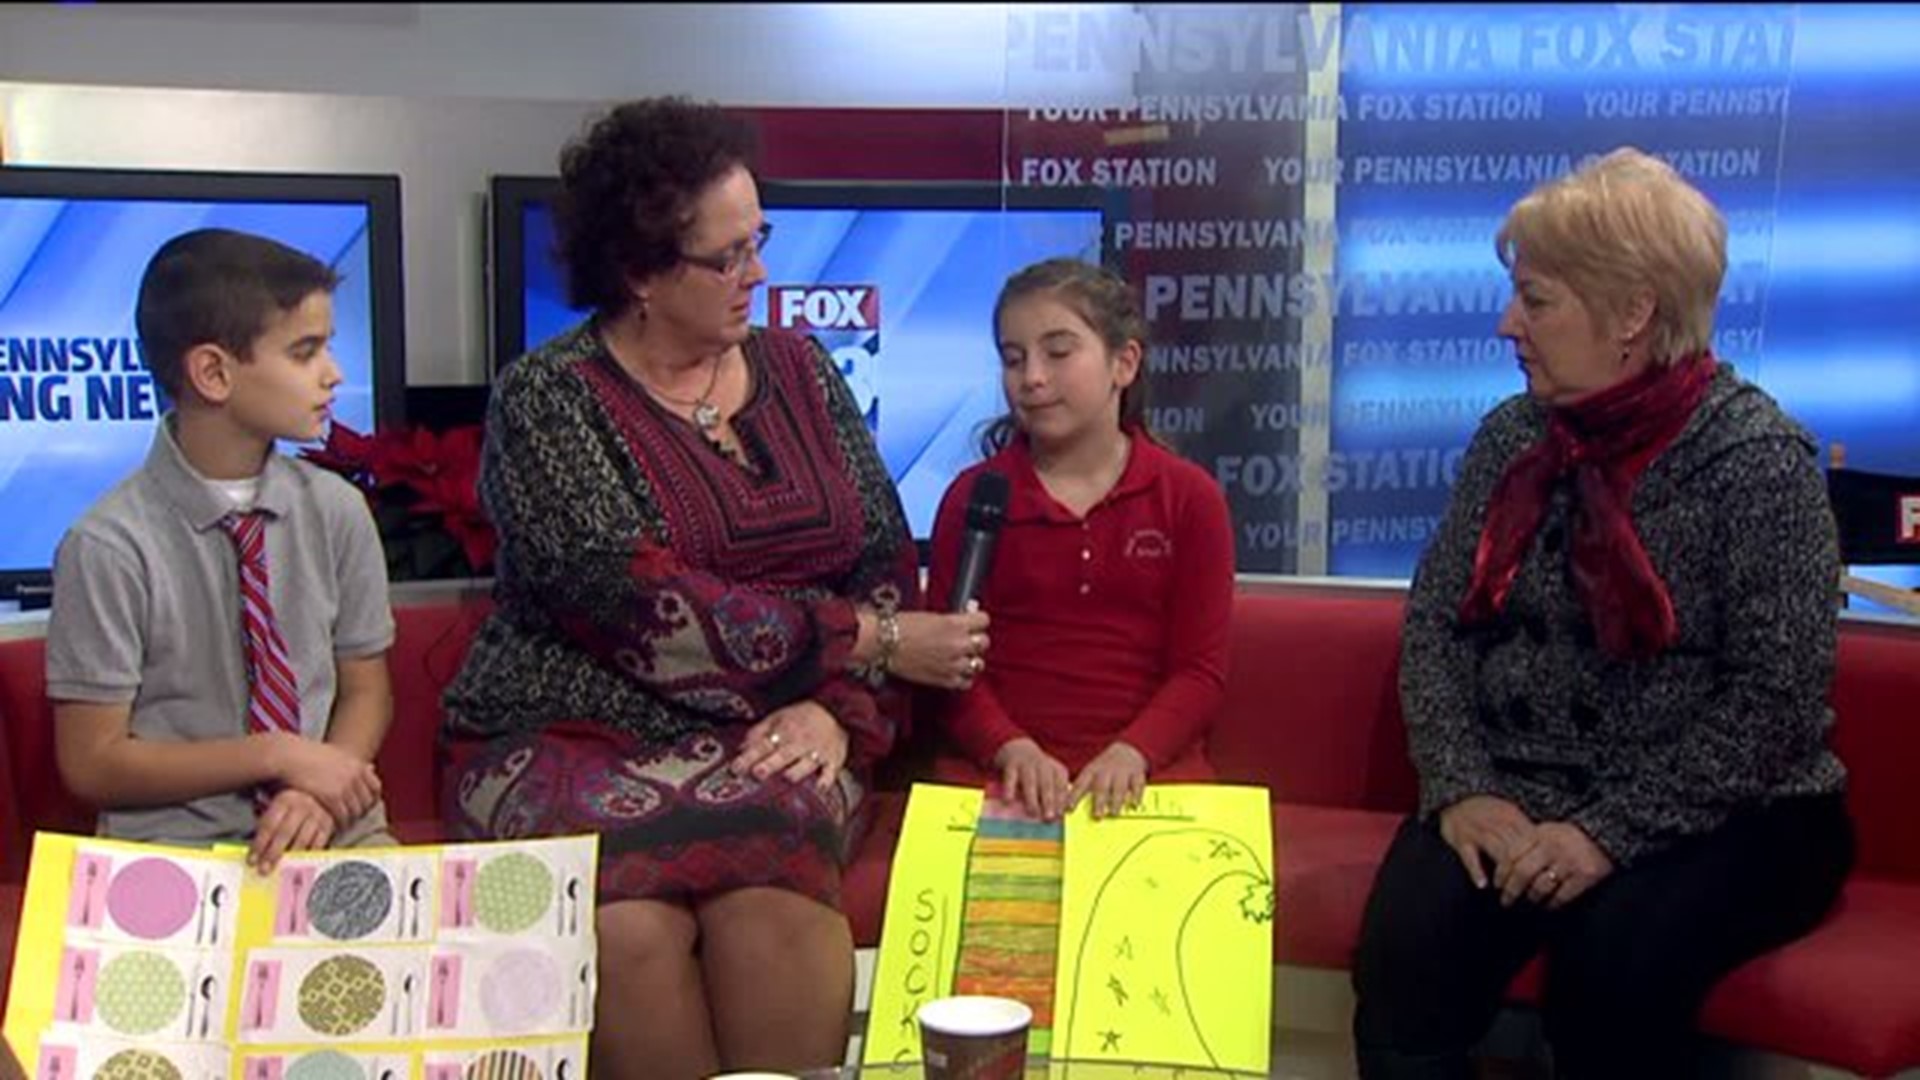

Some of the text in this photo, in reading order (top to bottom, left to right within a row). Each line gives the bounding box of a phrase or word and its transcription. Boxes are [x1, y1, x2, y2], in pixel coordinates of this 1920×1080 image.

[1520, 17, 1641, 70] FOX
[1119, 94, 1348, 121] PENNSYLVANIA
[1358, 93, 1416, 120] FOX
[1423, 91, 1543, 120] STATION
[1582, 89, 1660, 118] YOUR
[1021, 157, 1217, 187] FOX STATION
[1263, 156, 1343, 184] YOUR
[1354, 152, 1571, 184] PENNSYLVANIA
[780, 289, 867, 328] FOX
[1148, 343, 1331, 374] NNSYLVANIA
[1343, 340, 1398, 366] FOX
[86, 375, 170, 422] NE
[1217, 445, 1465, 496] FOX STATIO
